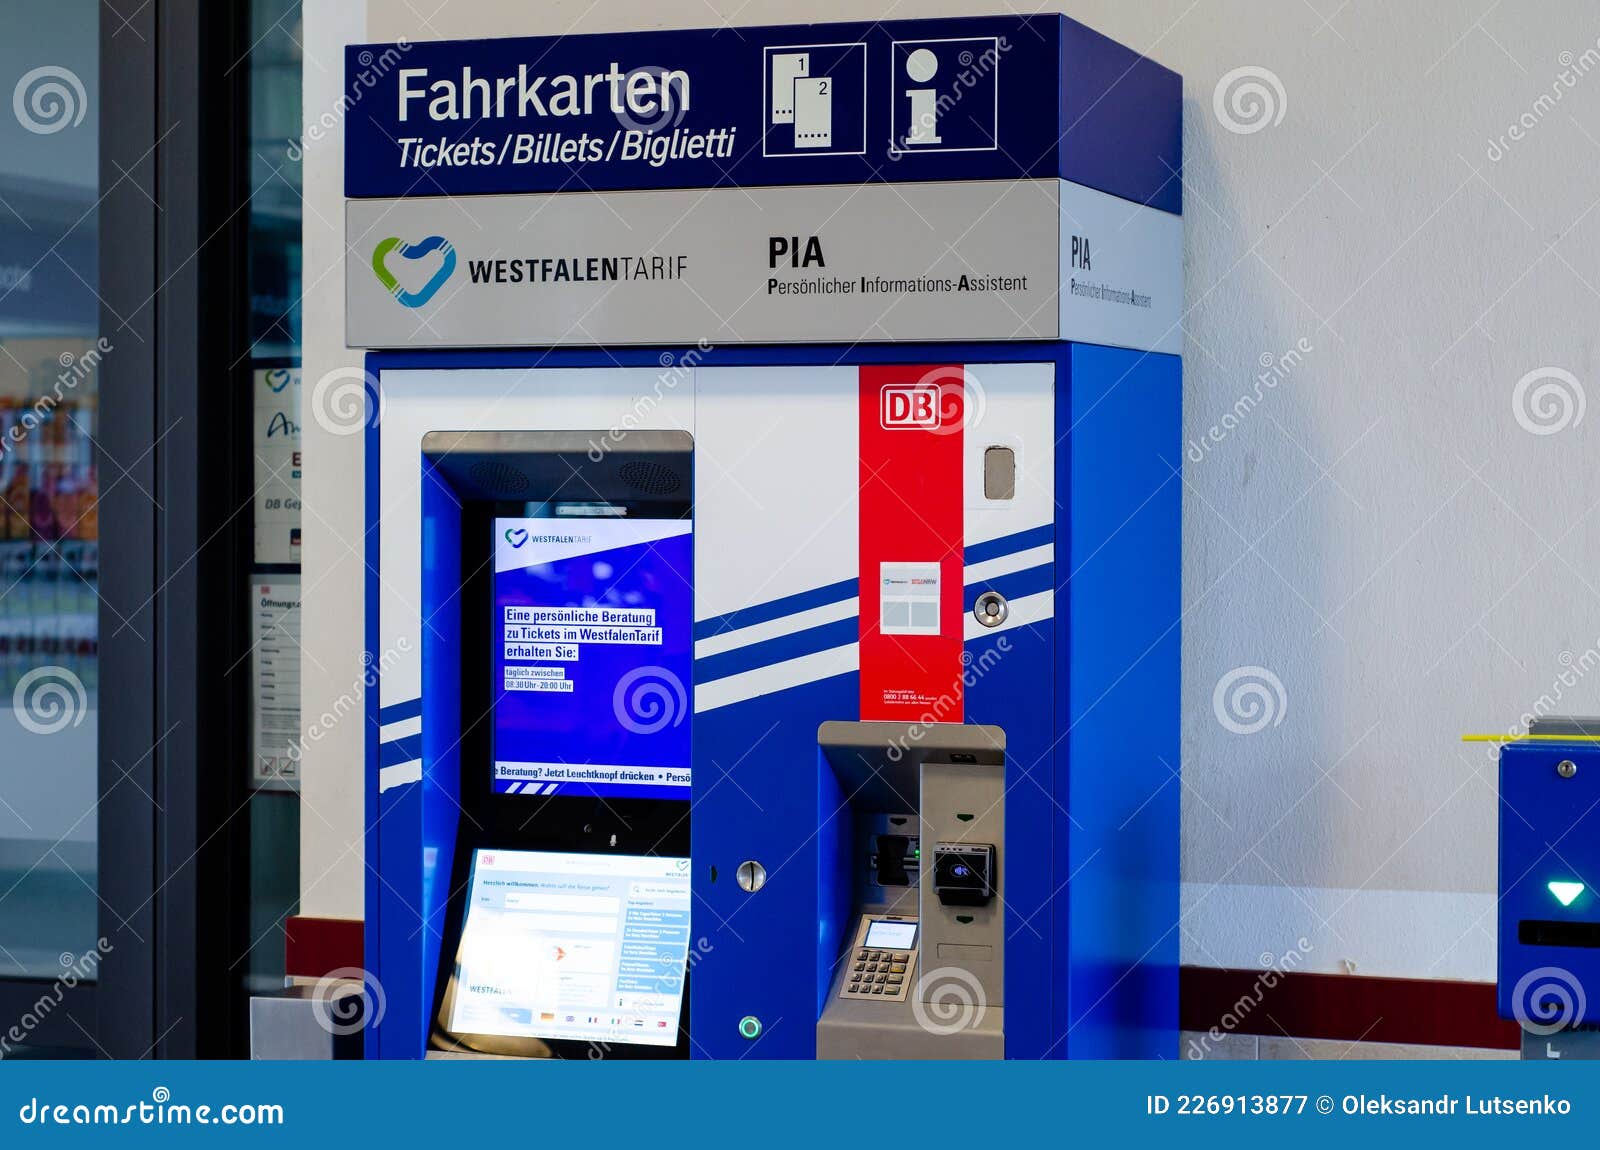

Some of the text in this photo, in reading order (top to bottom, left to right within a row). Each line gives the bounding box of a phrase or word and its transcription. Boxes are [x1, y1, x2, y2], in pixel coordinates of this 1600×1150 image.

[398, 62, 690, 122] Fahrkarten
[769, 235, 826, 269] PIA
[1071, 235, 1091, 271] PIA
[468, 255, 688, 283] WESTFALENTARIF
[768, 274, 1028, 295] Persönlicher Informations-Assistent
[885, 389, 936, 424] DB
[506, 608, 652, 626] Eine persönliche Beratung
[506, 627, 660, 642] zu Tickets im WestfalenTarif
[506, 645, 576, 658] erhalten Sie:
[531, 669, 564, 677] zwischen
[501, 766, 543, 778] Beratung?
[544, 768, 565, 778] Jetzt
[567, 769, 618, 781] Leuchtknopf
[620, 771, 654, 781] drücken
